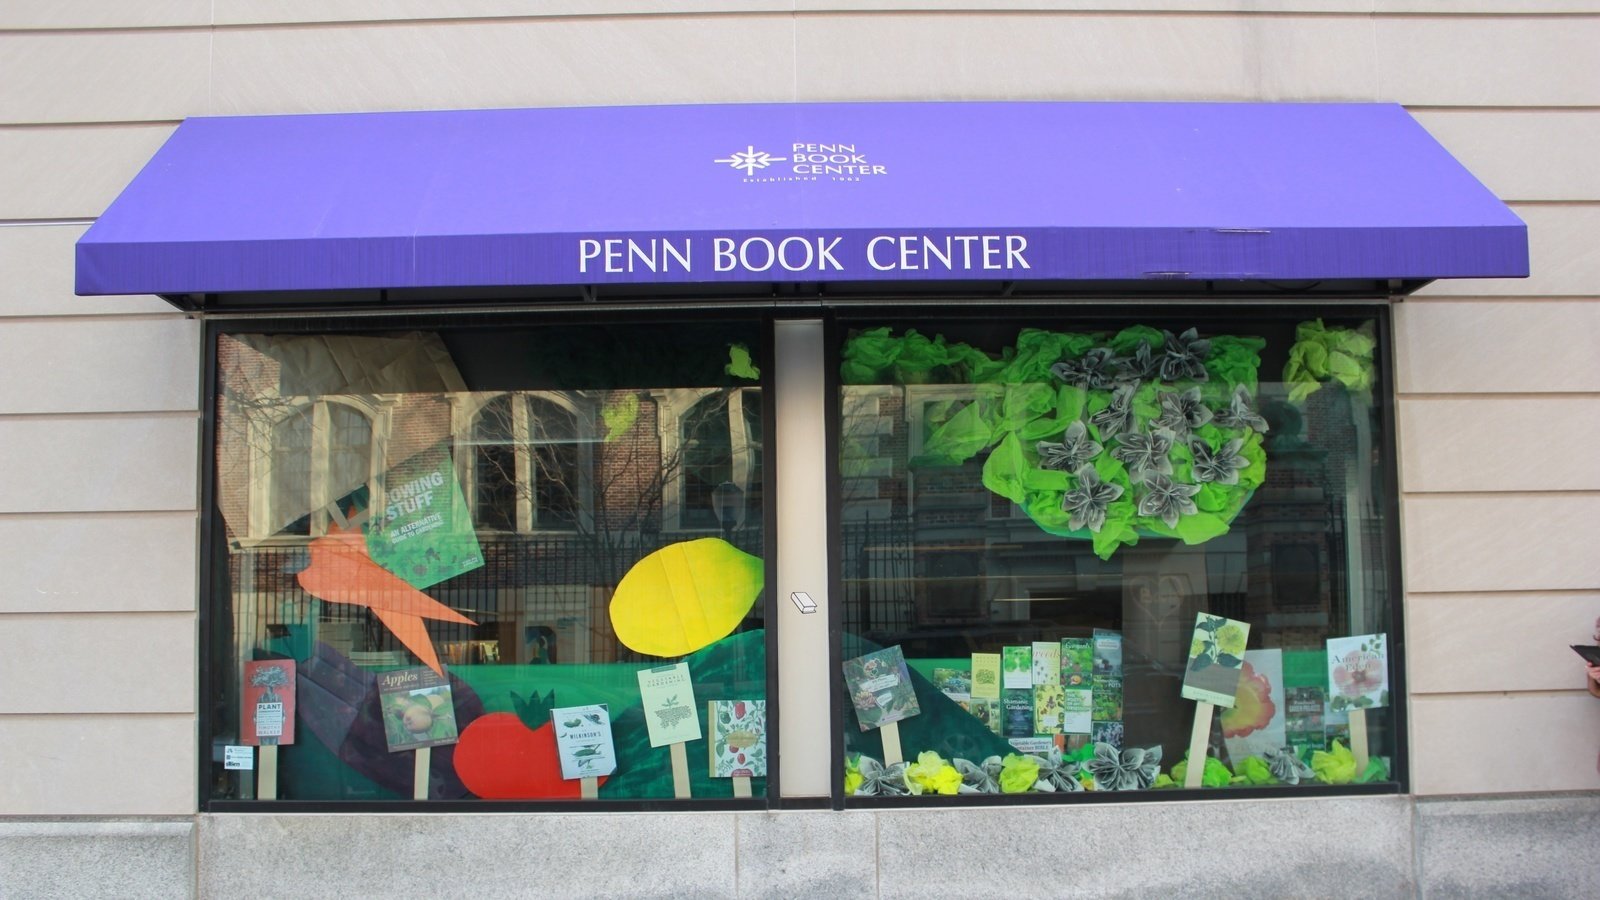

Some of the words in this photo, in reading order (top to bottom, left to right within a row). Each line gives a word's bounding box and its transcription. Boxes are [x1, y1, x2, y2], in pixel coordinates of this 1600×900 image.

[792, 143, 856, 153] PENN
[793, 153, 867, 164] BOOK
[792, 164, 888, 175] CENTER
[579, 238, 691, 273] PENN
[714, 236, 845, 272] BOOK
[866, 235, 1031, 271] CENTER
[386, 490, 433, 520] STUFF
[391, 528, 400, 538] AN
[401, 512, 441, 534] ALTERNATIVE
[1332, 653, 1385, 664] American
[1346, 662, 1372, 671] Eden
[381, 671, 418, 687] Apples
